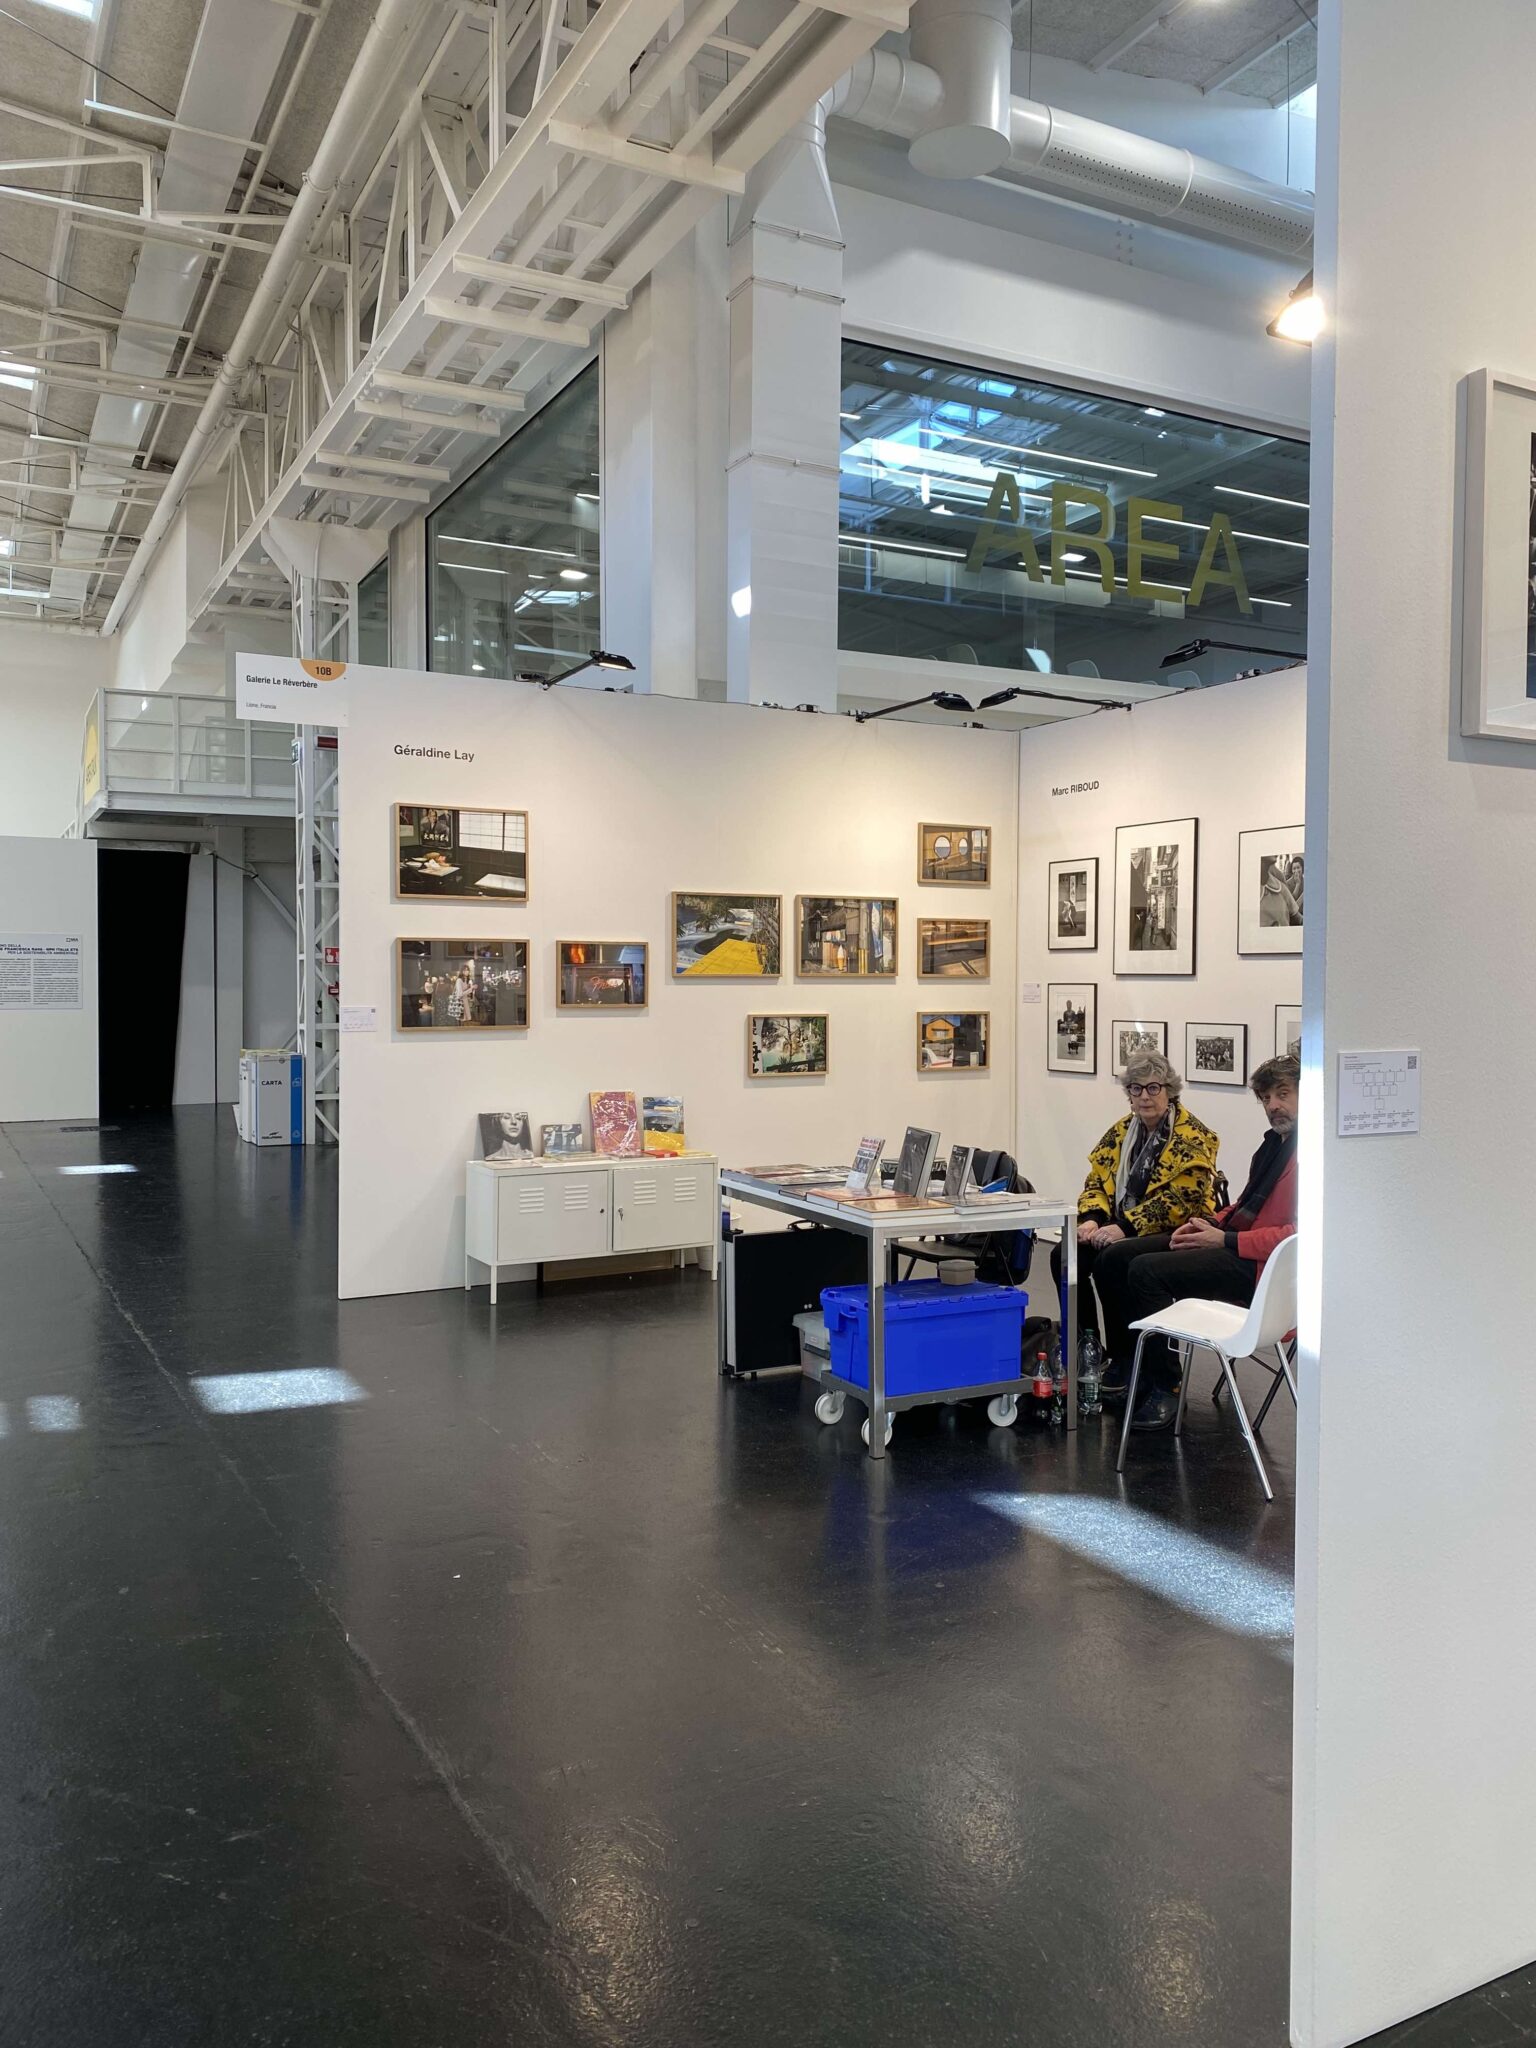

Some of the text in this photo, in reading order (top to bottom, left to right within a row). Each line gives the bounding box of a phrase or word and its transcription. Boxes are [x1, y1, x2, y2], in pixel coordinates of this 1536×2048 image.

[965, 471, 1254, 615] AREA
[315, 666, 332, 676] 10B
[246, 675, 318, 688] Galerie Le Réverbère
[394, 744, 475, 763] Géraldine Lay
[1052, 780, 1100, 796] Marc RIBOUD
